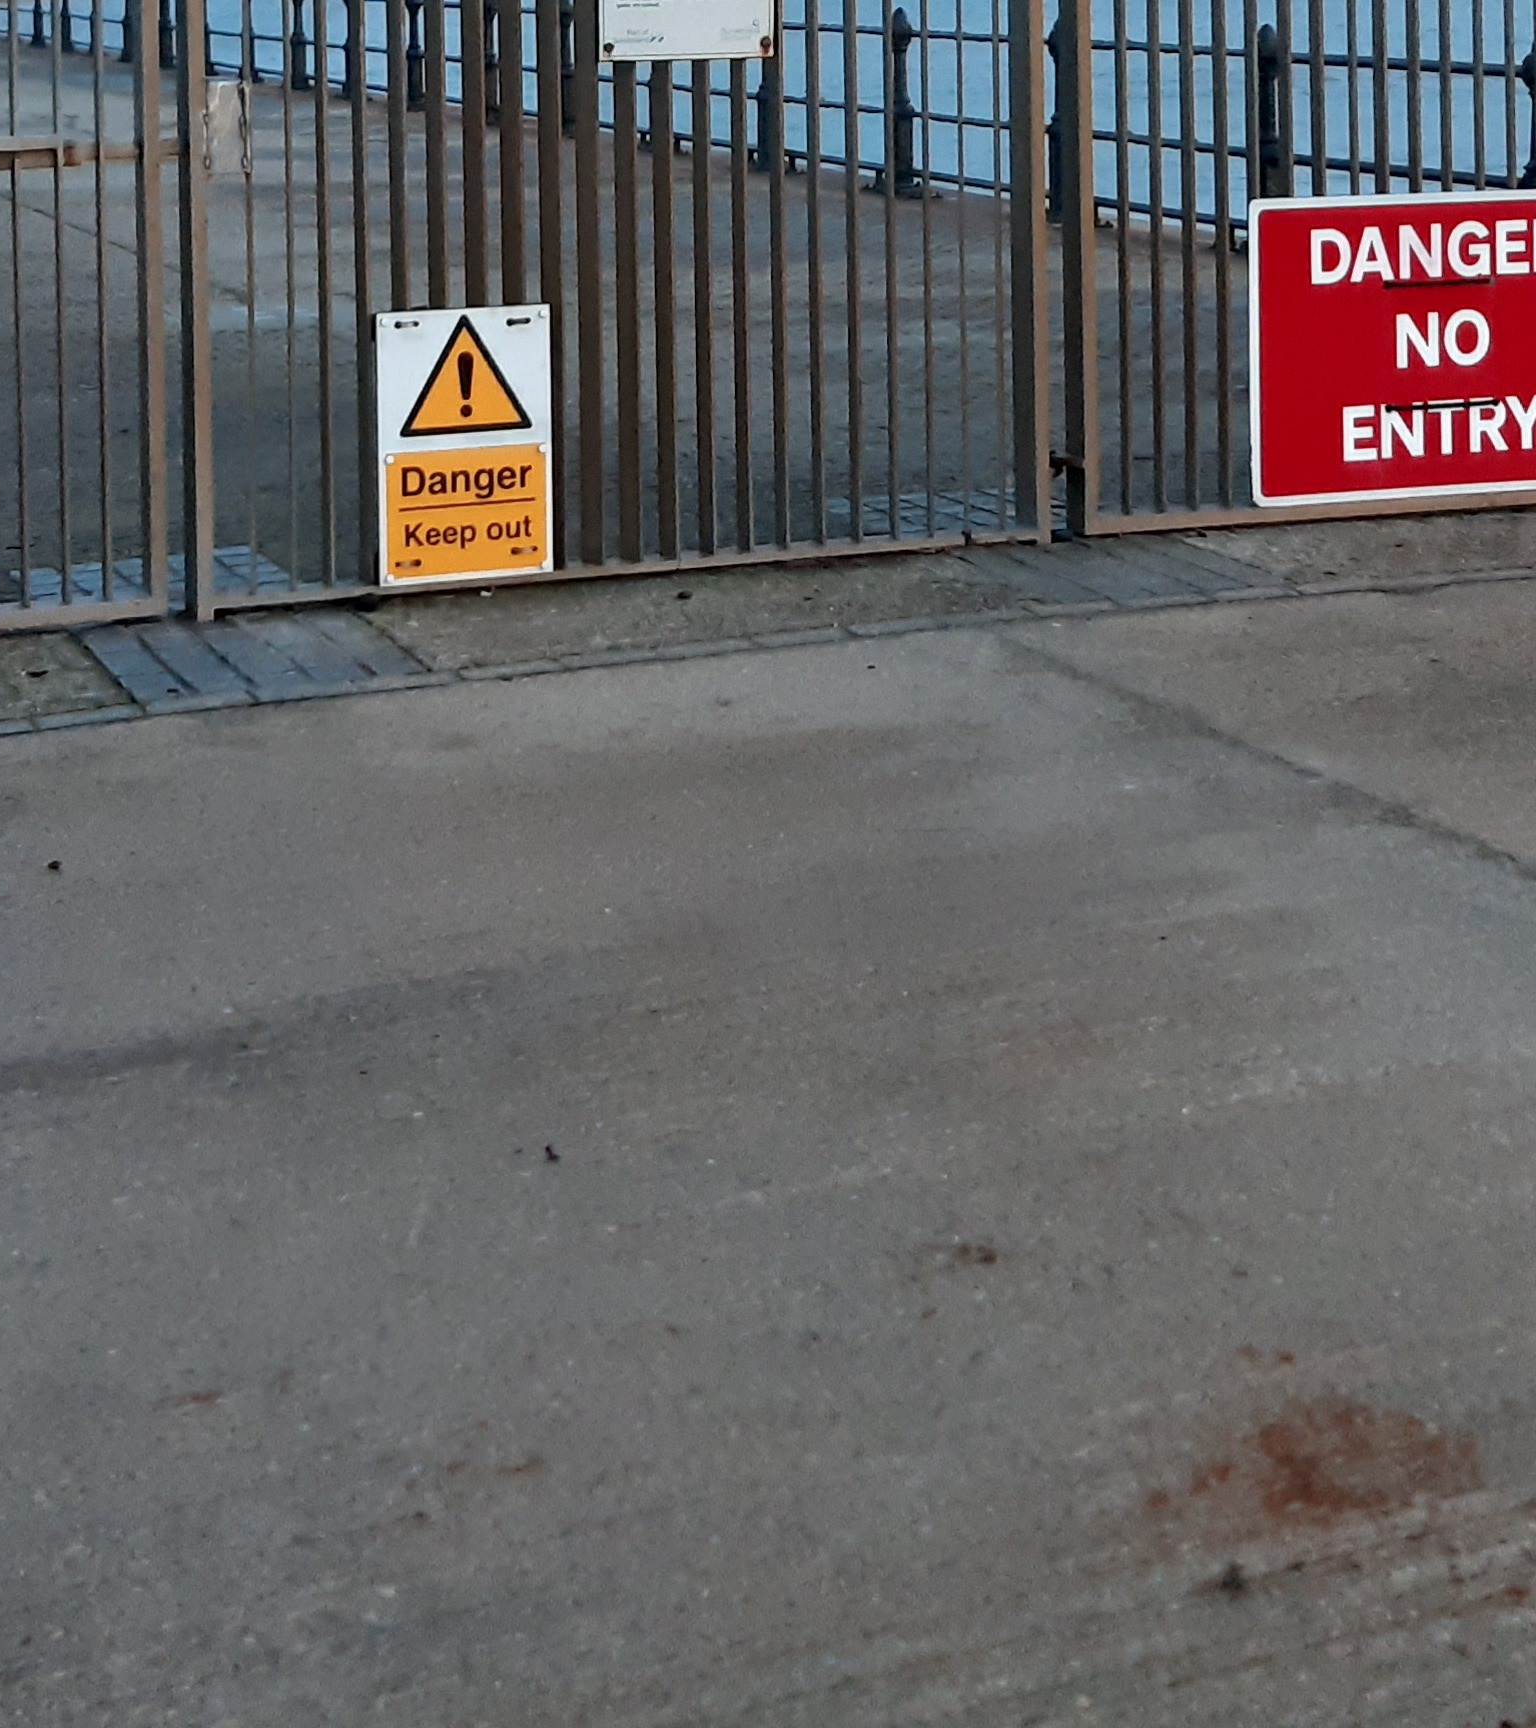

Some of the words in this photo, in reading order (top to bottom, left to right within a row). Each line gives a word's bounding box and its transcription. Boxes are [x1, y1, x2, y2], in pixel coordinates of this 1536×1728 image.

[1395, 309, 1491, 369] NO
[401, 465, 532, 499] Danger
[404, 522, 477, 549] Keep
[486, 515, 531, 540] out
